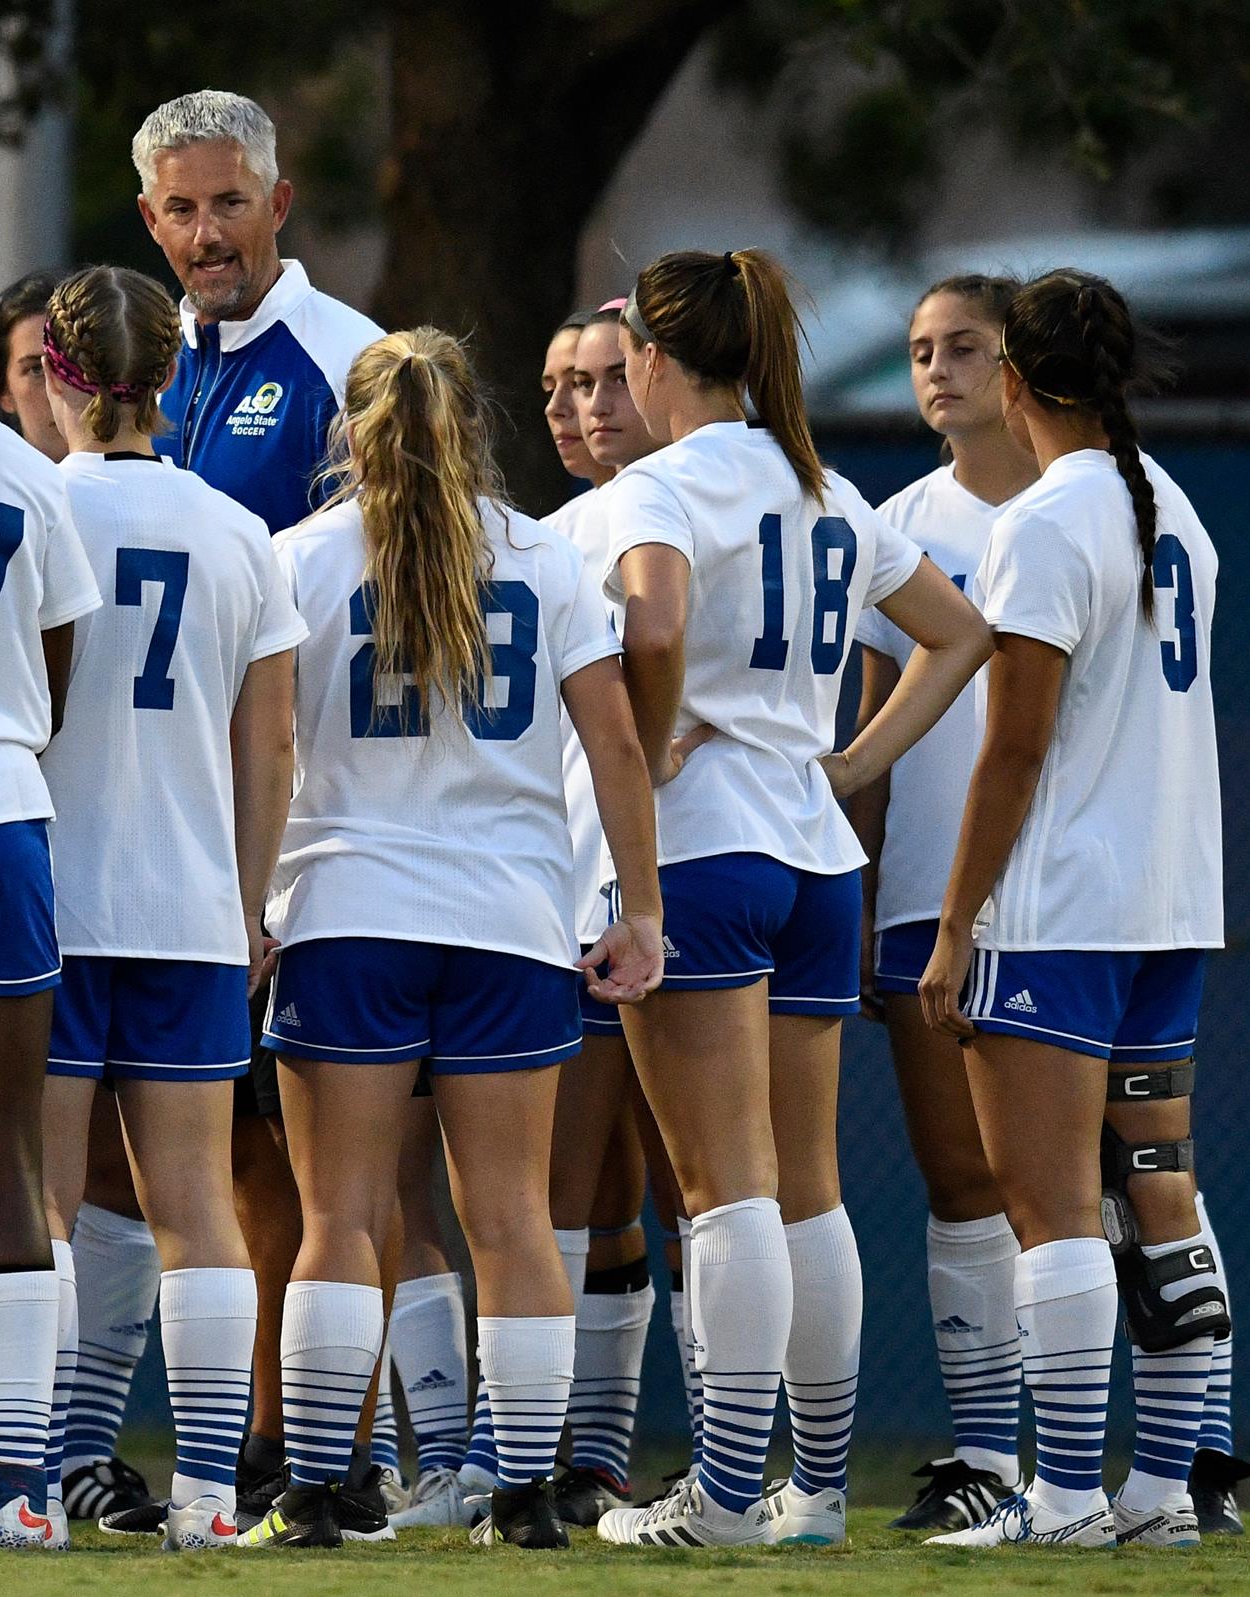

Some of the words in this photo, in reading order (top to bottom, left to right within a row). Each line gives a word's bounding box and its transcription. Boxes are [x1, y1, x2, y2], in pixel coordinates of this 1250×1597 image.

[226, 414, 253, 427] Angelo
[253, 415, 277, 426] State
[232, 427, 265, 436] SOCCER
[750, 513, 857, 675] 18
[1153, 534, 1198, 693] 3
[115, 547, 190, 710] 7
[349, 580, 539, 741] 28
[663, 950, 680, 958] das
[1004, 1001, 1038, 1014] adidas
[276, 1015, 302, 1027] adidas
[1167, 1524, 1199, 1534] TIEM
